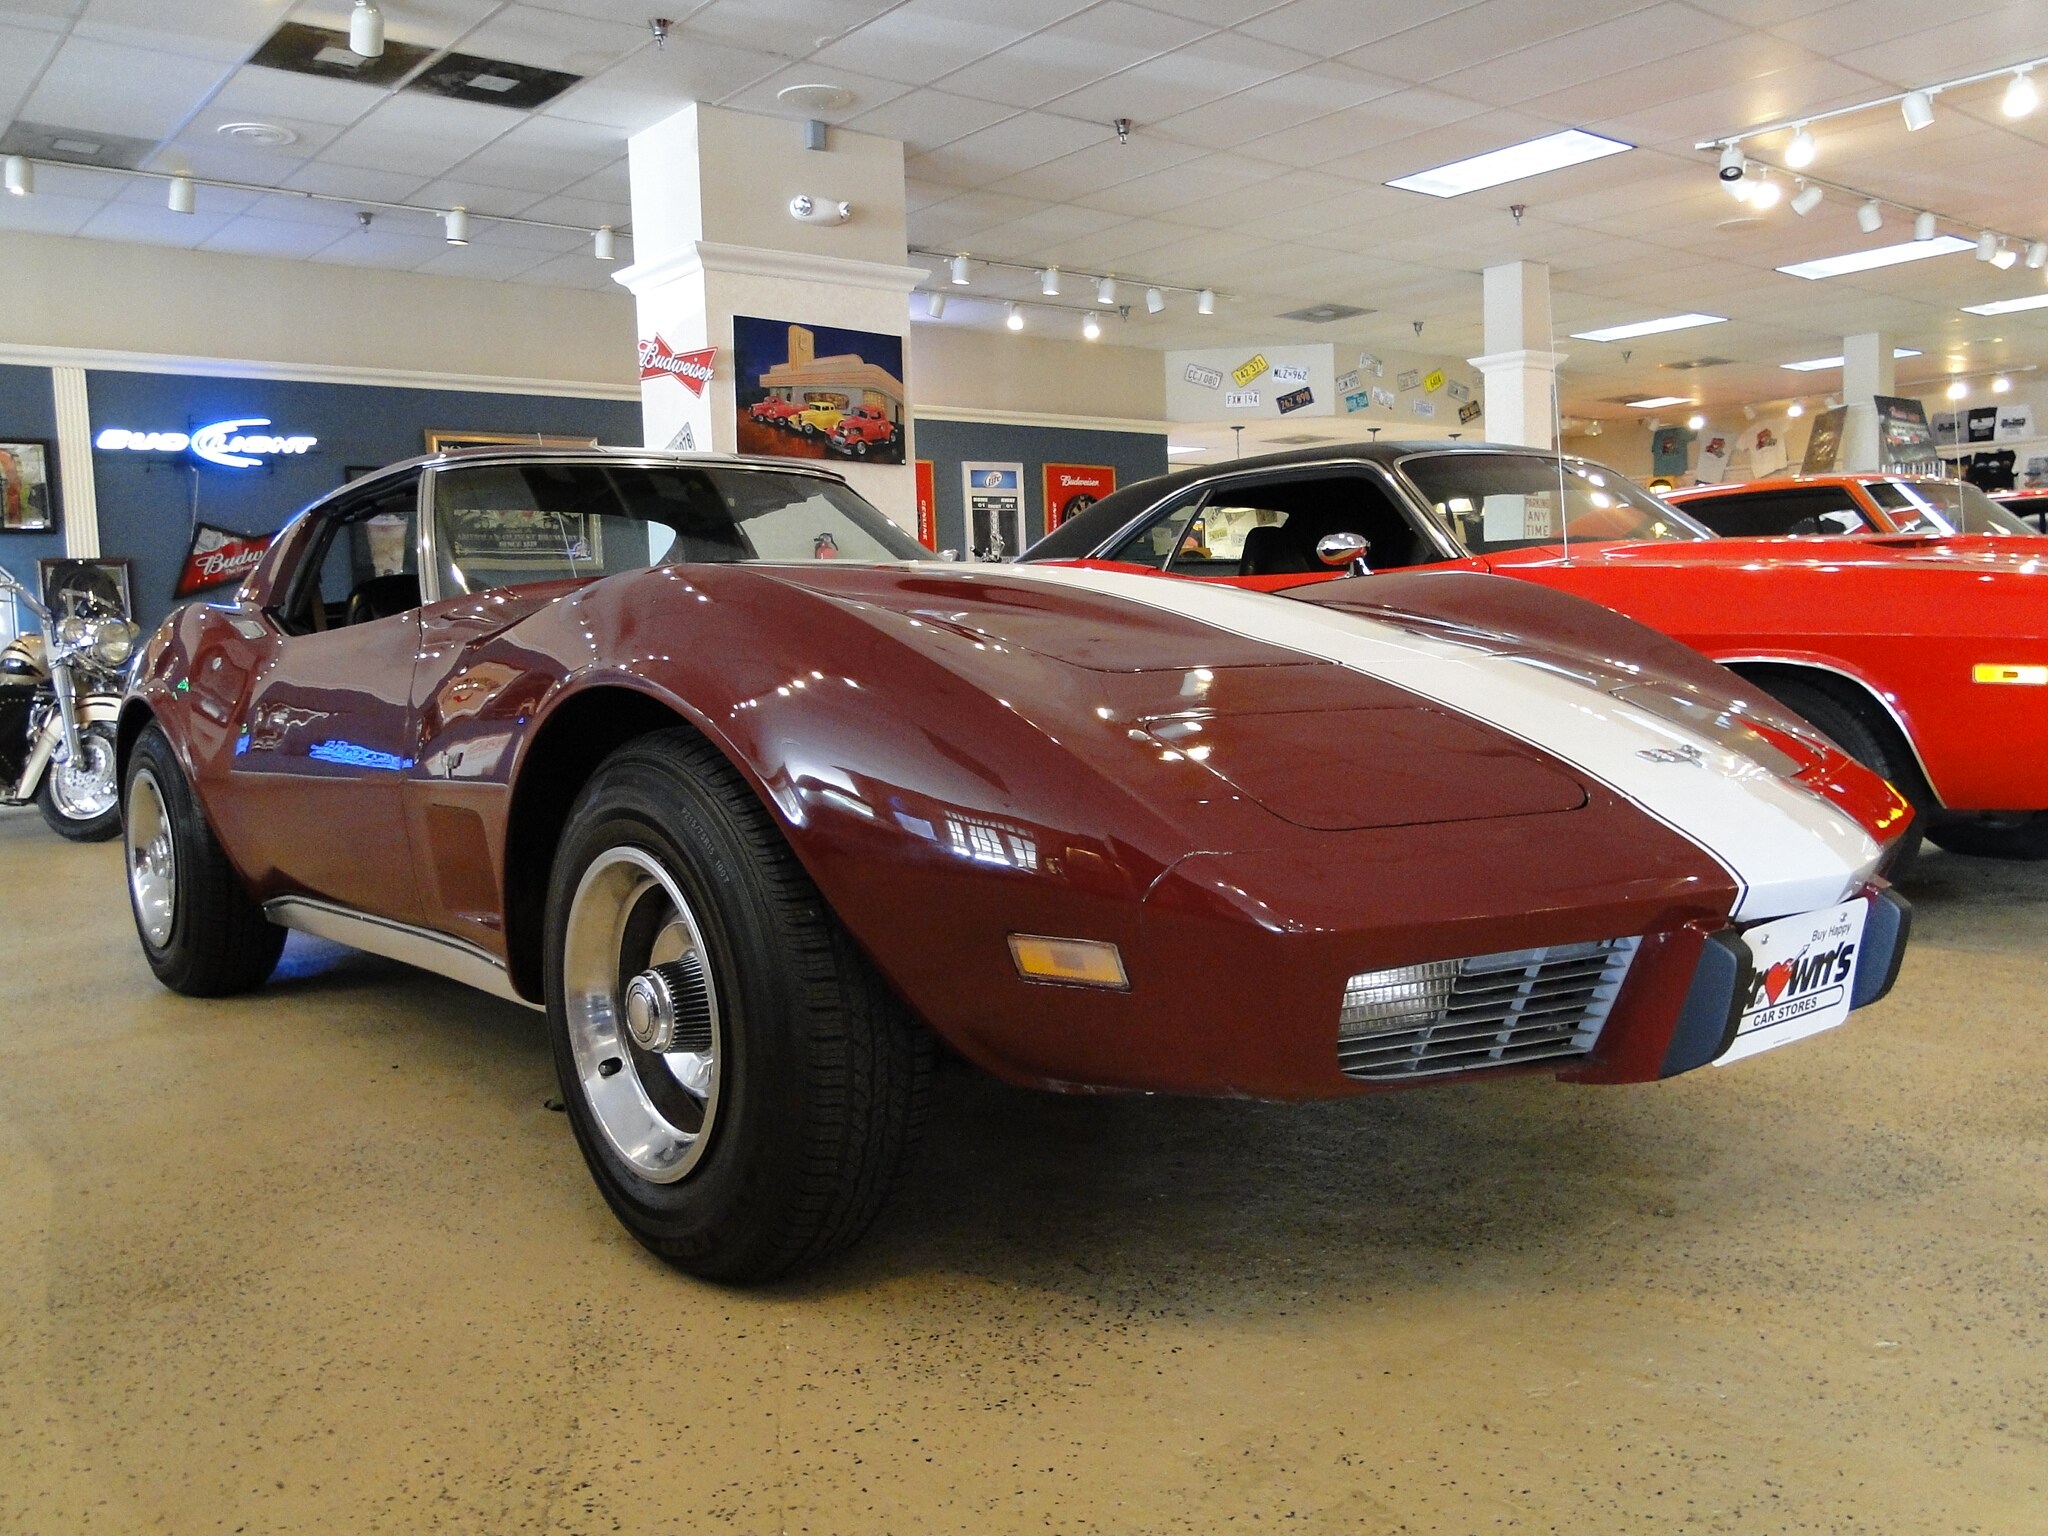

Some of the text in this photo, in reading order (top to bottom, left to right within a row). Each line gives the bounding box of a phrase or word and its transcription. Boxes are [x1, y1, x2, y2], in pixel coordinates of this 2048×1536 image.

[638, 340, 714, 381] Budweiser
[1244, 395, 1258, 404] 194
[96, 428, 318, 454] BUD LIGHT
[1060, 475, 1099, 487] Budweiser
[1528, 511, 1547, 522] ANY
[1526, 524, 1549, 537] TIME
[1811, 923, 1851, 942] Buy Happy
[1753, 996, 1818, 1027] CAR STORES
